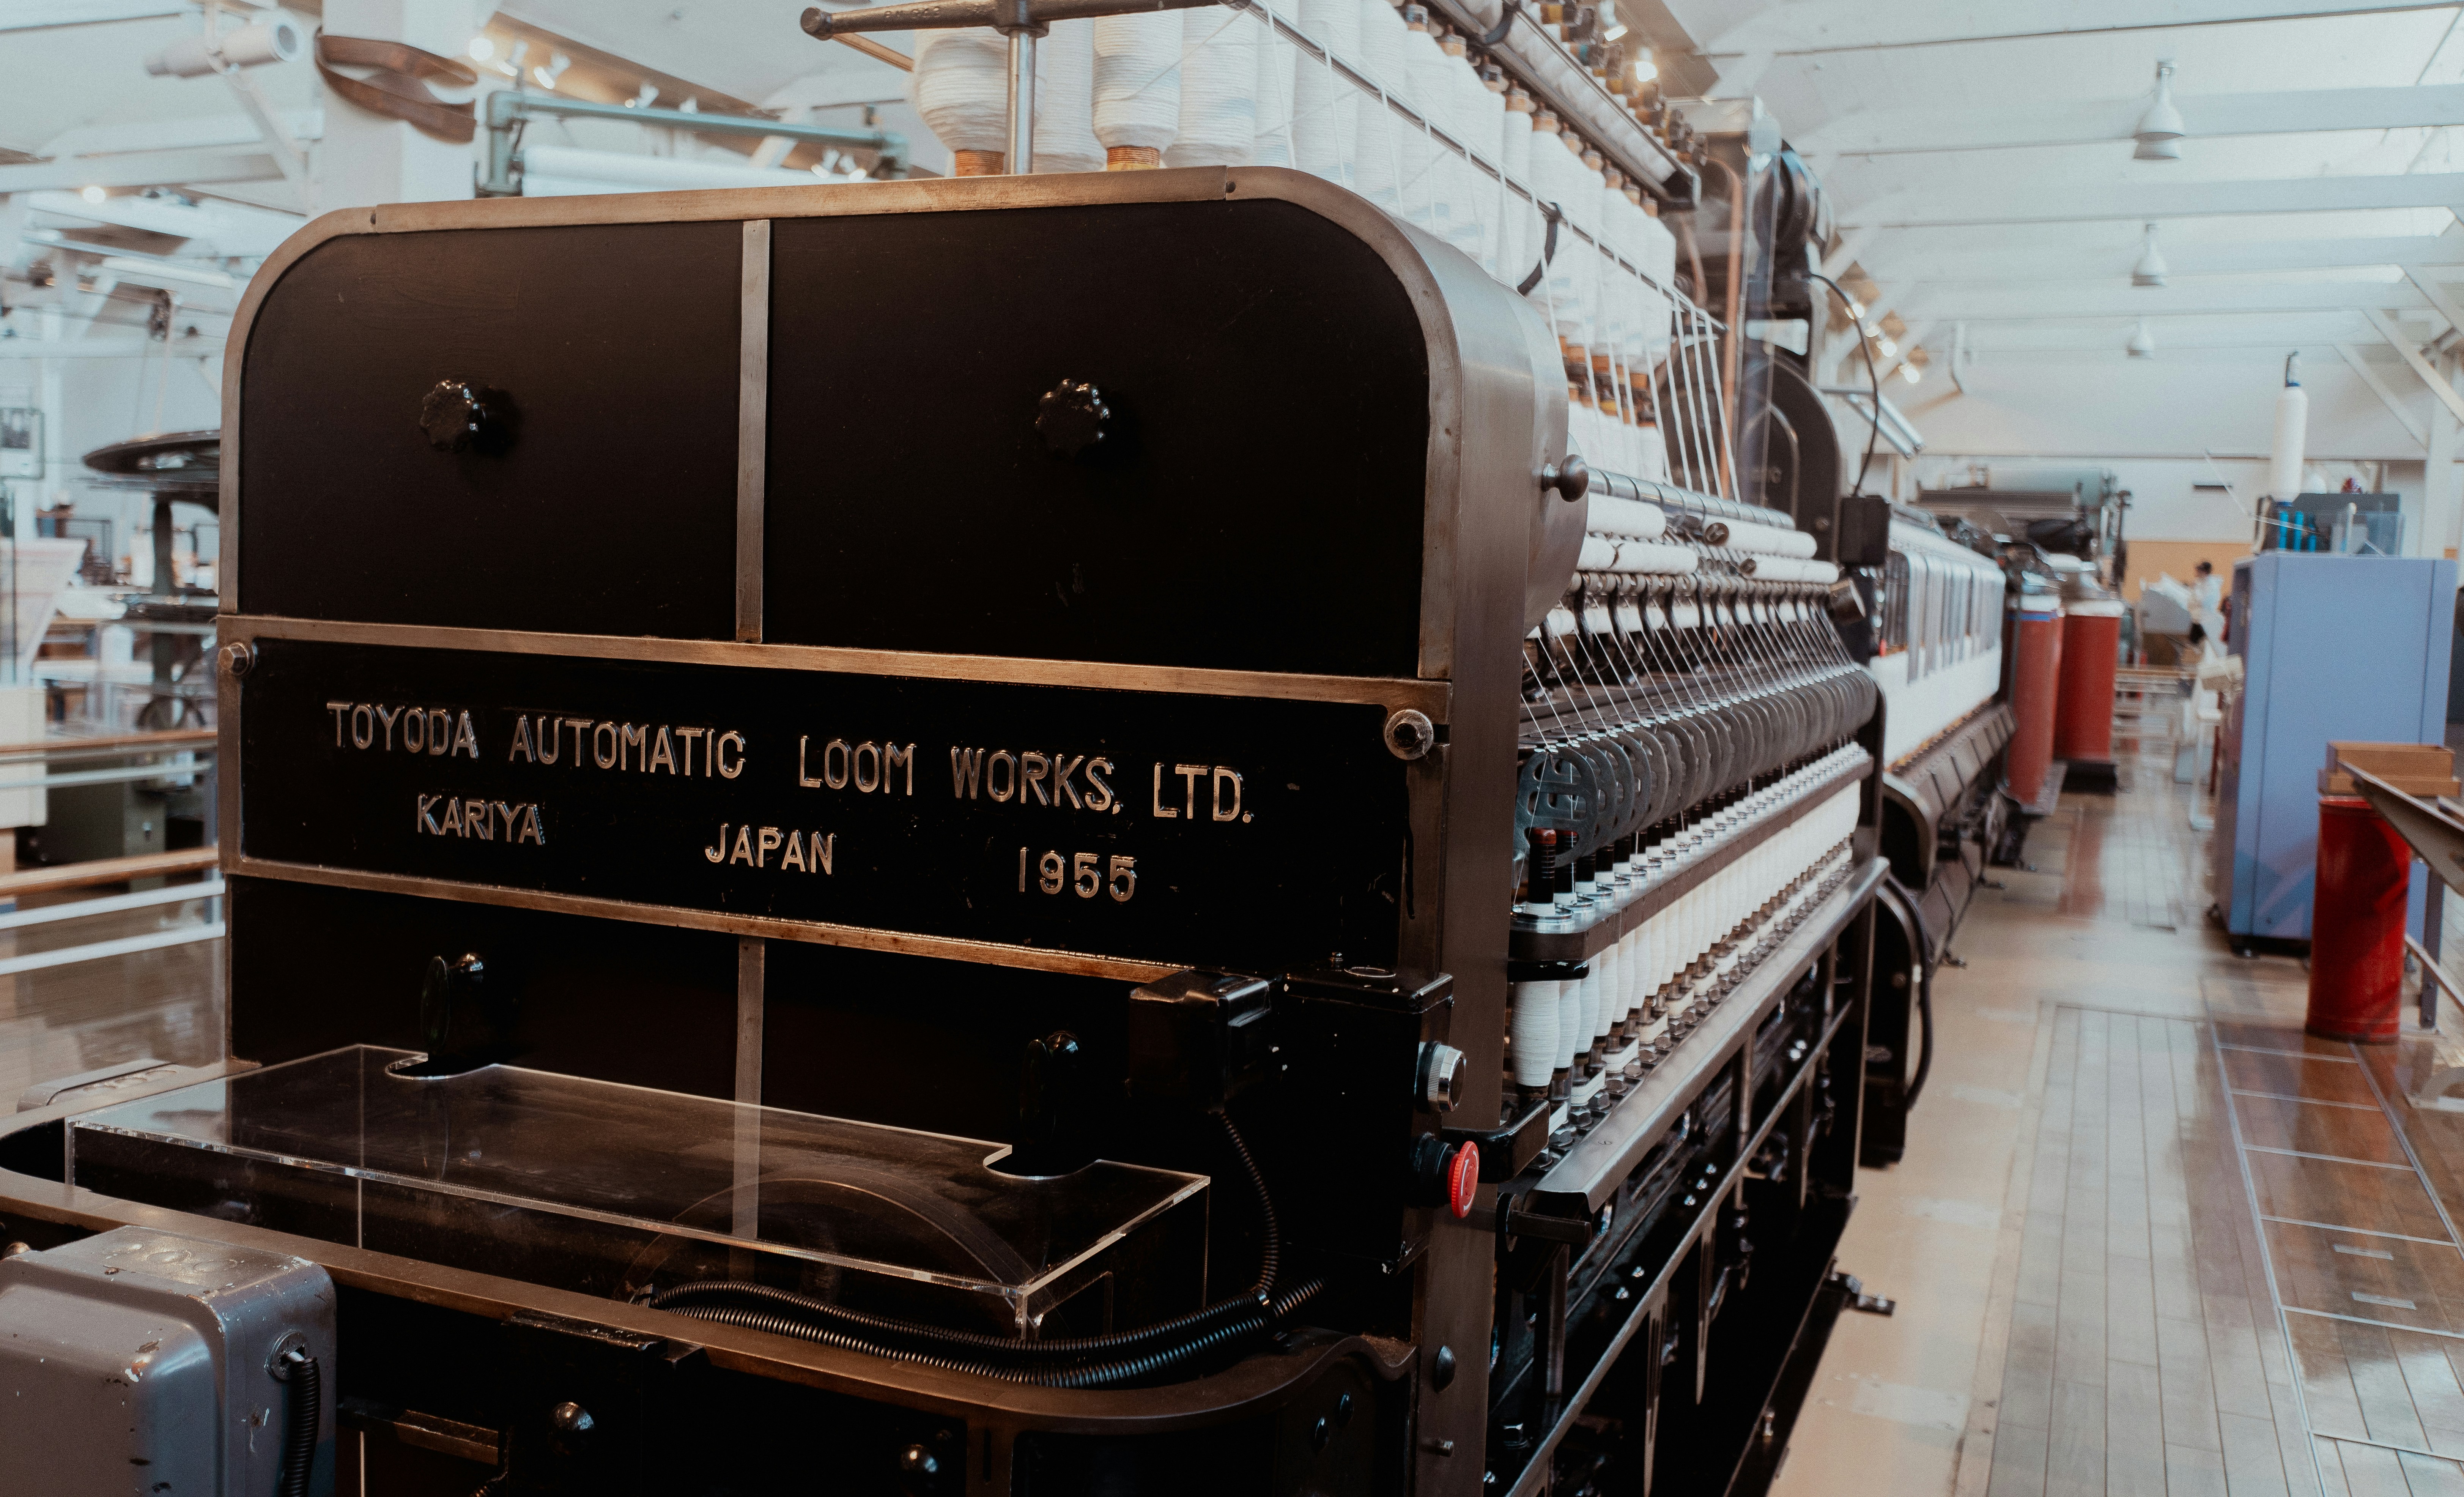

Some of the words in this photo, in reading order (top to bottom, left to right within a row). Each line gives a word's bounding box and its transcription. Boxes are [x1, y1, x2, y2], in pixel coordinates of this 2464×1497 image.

[327, 701, 479, 759] TOYODA
[509, 715, 746, 779] AUTOMATIC
[800, 735, 916, 796] LOOM
[951, 746, 1123, 815] WORKS,
[1154, 763, 1254, 823] LTD.
[417, 793, 545, 845] KARIYA
[705, 823, 836, 875] JAPAN
[1019, 847, 1137, 902] 1955
